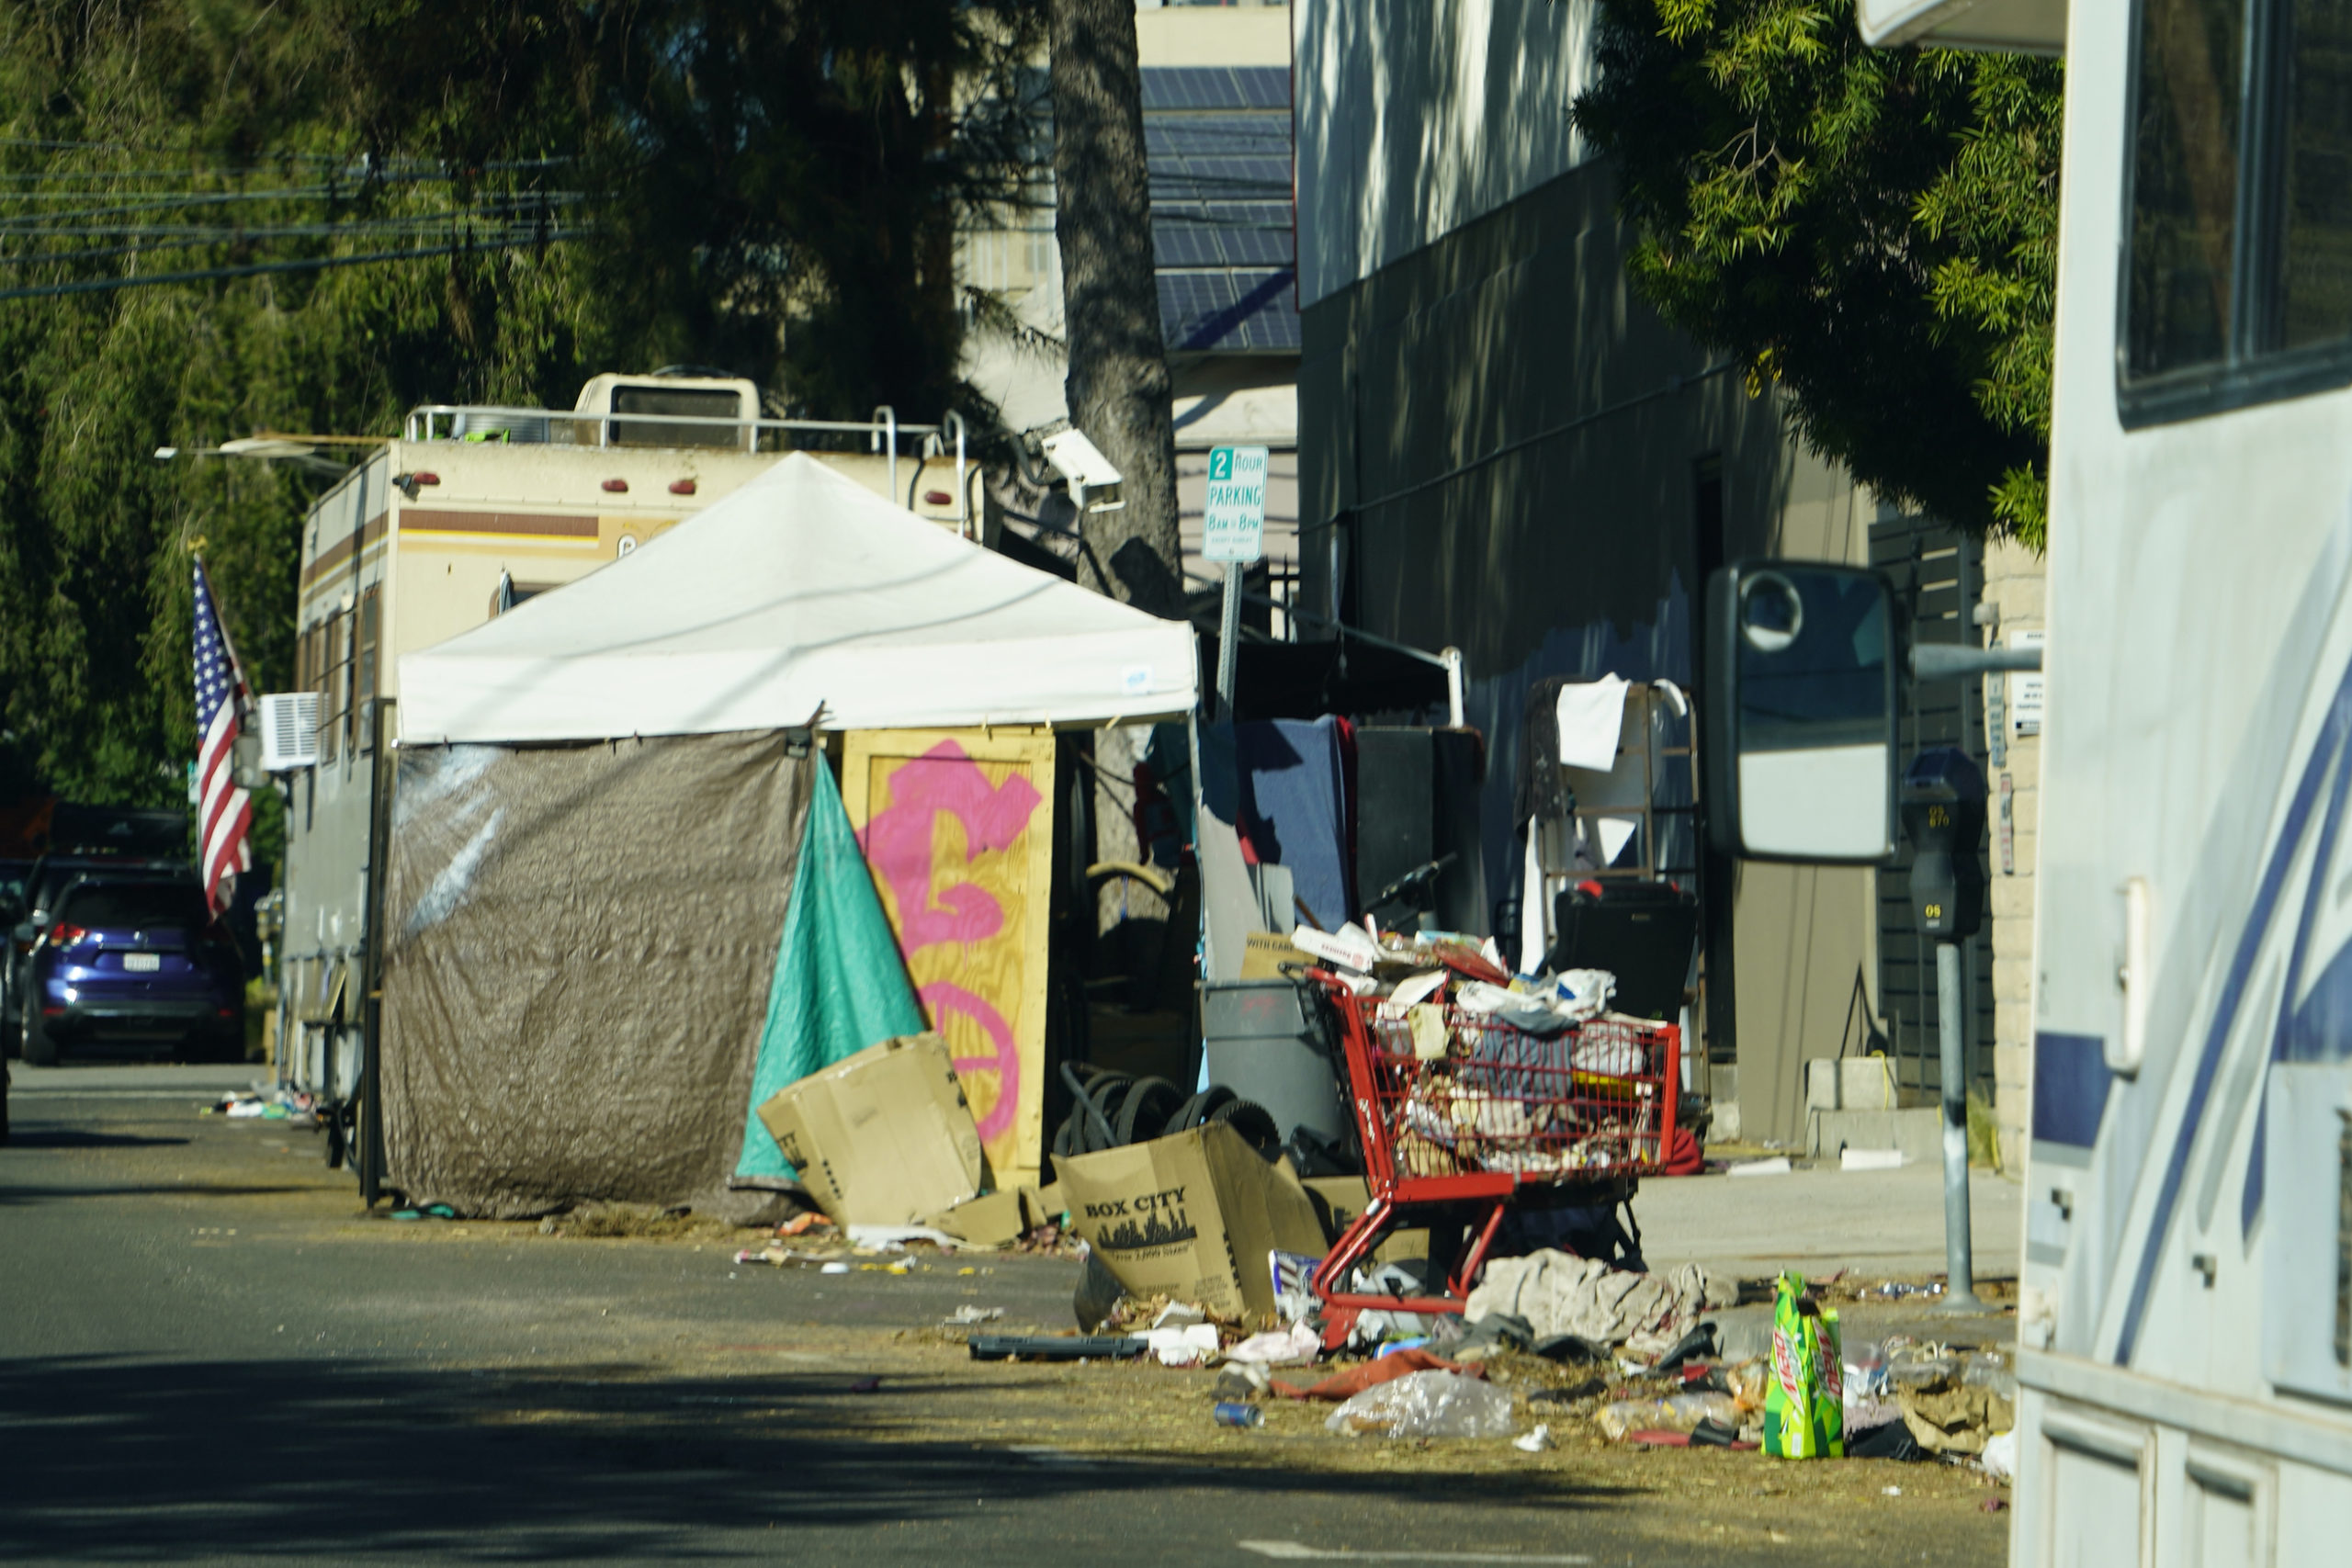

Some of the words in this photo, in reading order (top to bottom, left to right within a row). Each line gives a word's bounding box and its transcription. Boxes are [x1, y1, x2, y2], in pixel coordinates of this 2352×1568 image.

[1215, 451, 1227, 477] 2
[1209, 485, 1261, 507] PARKING
[1208, 513, 1228, 531] 8AM
[1238, 513, 1259, 531] 8PM
[1247, 937, 1270, 951] WITH
[1085, 1200, 1128, 1218] BOX
[1134, 1186, 1185, 1212] CITY
